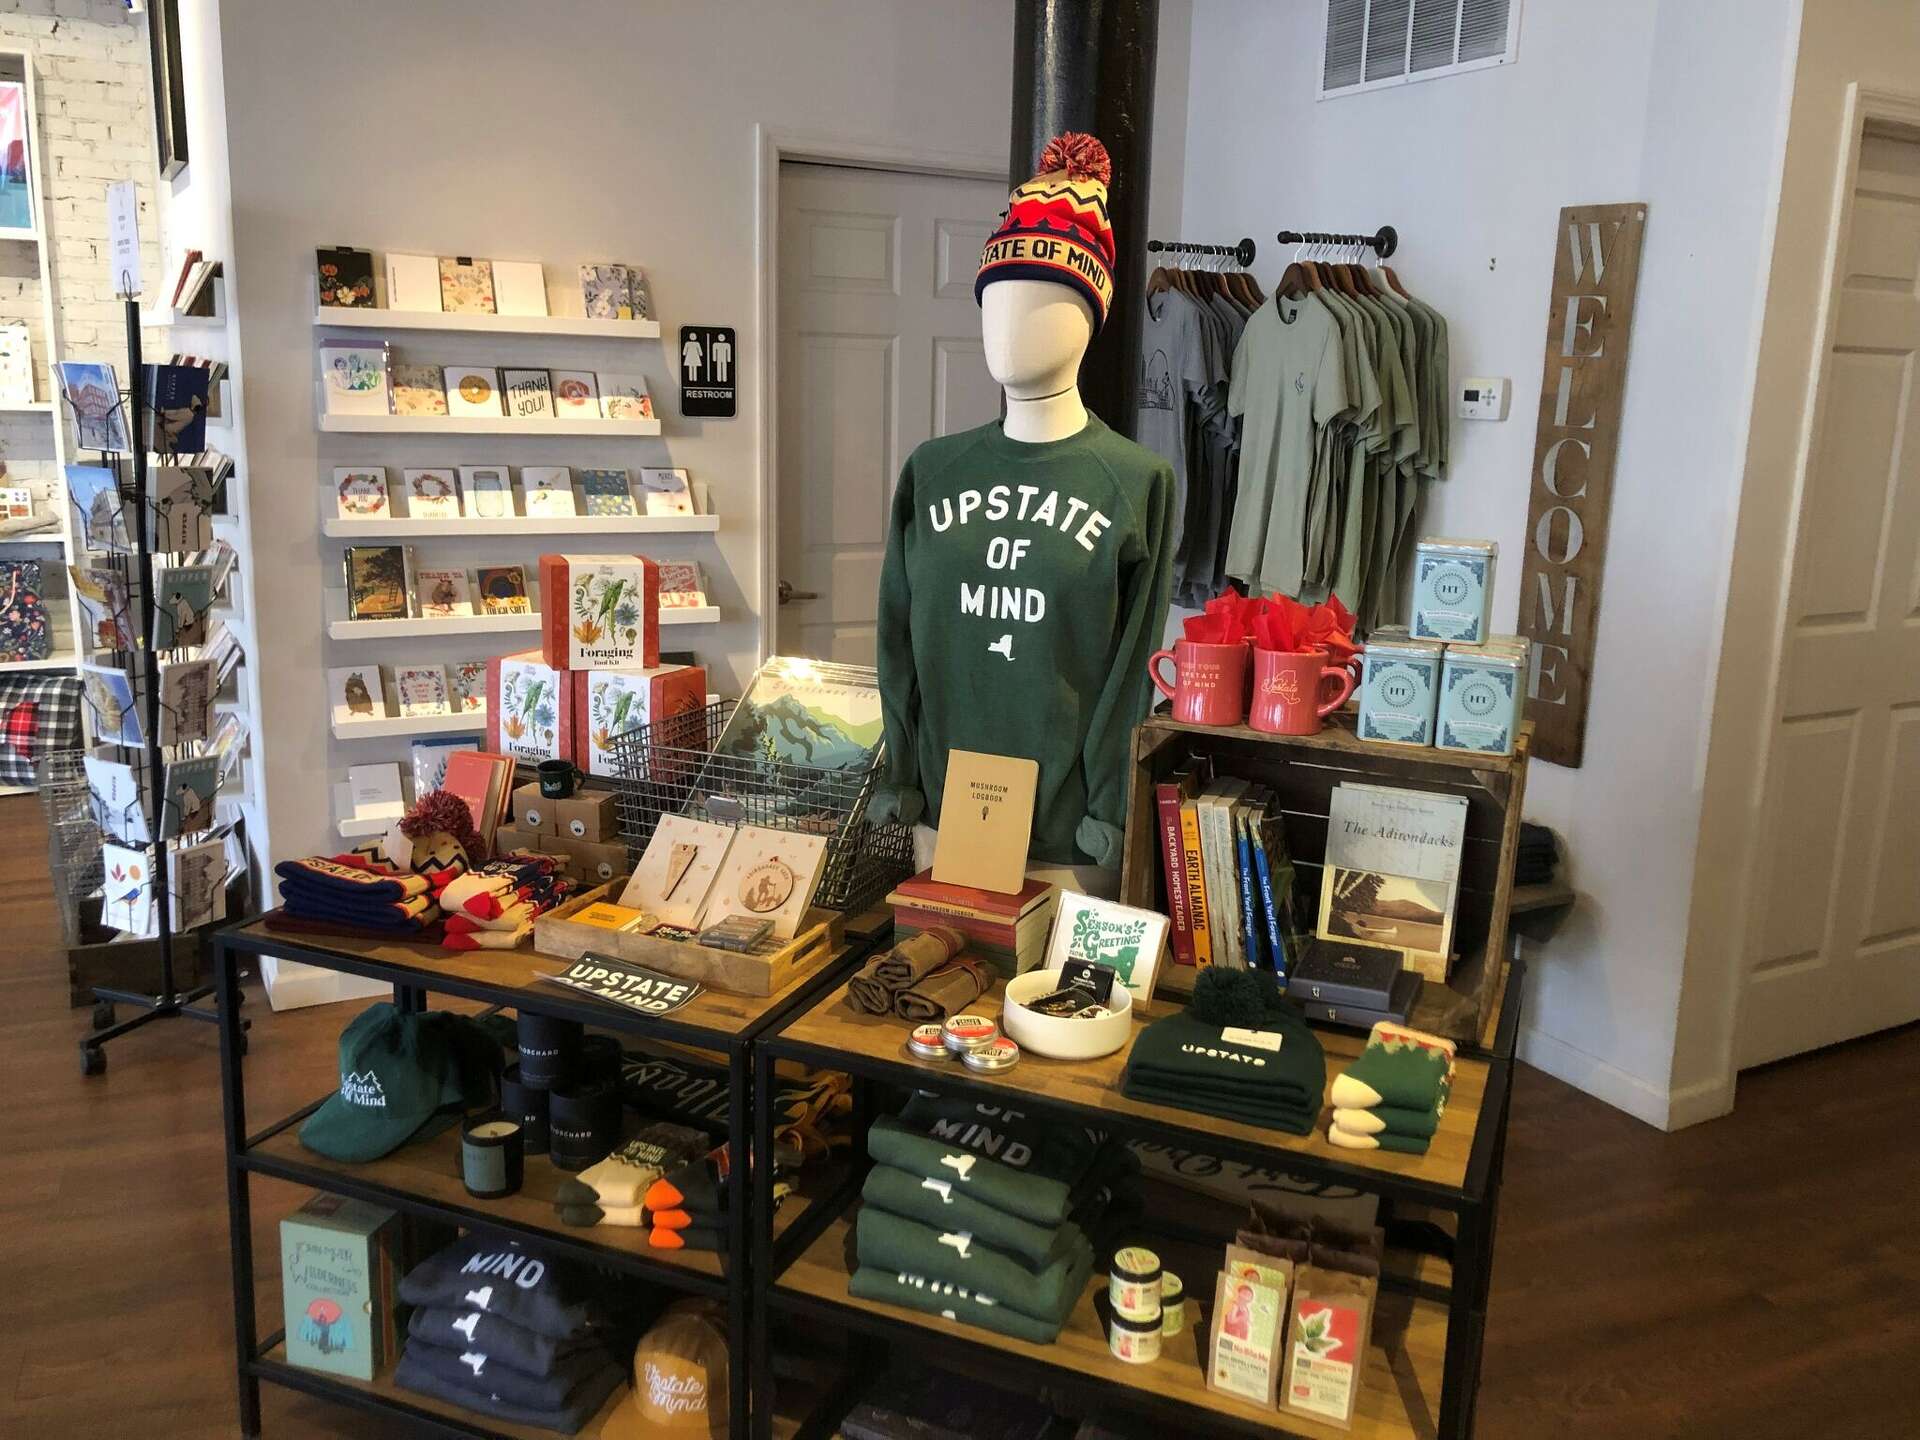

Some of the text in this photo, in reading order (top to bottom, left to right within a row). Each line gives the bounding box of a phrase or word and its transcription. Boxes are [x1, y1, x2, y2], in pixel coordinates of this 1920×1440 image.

[1032, 239, 1061, 260] OF
[1067, 246, 1105, 290] MIND
[510, 377, 548, 399] THANK
[686, 390, 732, 399] RESTROOM
[518, 399, 545, 416] YOU!
[1527, 223, 1623, 705] WELCOME
[929, 485, 1112, 551] UPSTATE
[986, 536, 1031, 570] OF
[960, 582, 1046, 623] MIND
[580, 648, 634, 659] Foraging
[509, 742, 551, 758] Foraging
[970, 781, 1008, 793] MUSHROOM
[972, 792, 1003, 802] LOGBOOK
[1343, 820, 1455, 849] The Adirondacks
[1166, 826, 1186, 931] BACKYARD HOMESTEADER
[1185, 850, 1195, 880] EARTH
[1188, 881, 1206, 931] ALMANAC
[1263, 885, 1272, 904] Front
[1073, 910, 1132, 935] SEASON'S
[1267, 905, 1276, 921] Yard
[1083, 930, 1141, 959] GREETINGS
[569, 964, 688, 1001] UPSTATE
[1181, 1043, 1266, 1067] UPSTATE
[354, 1094, 386, 1107] Mind
[929, 1118, 1032, 1166] MIND
[461, 1253, 545, 1289] MIND
